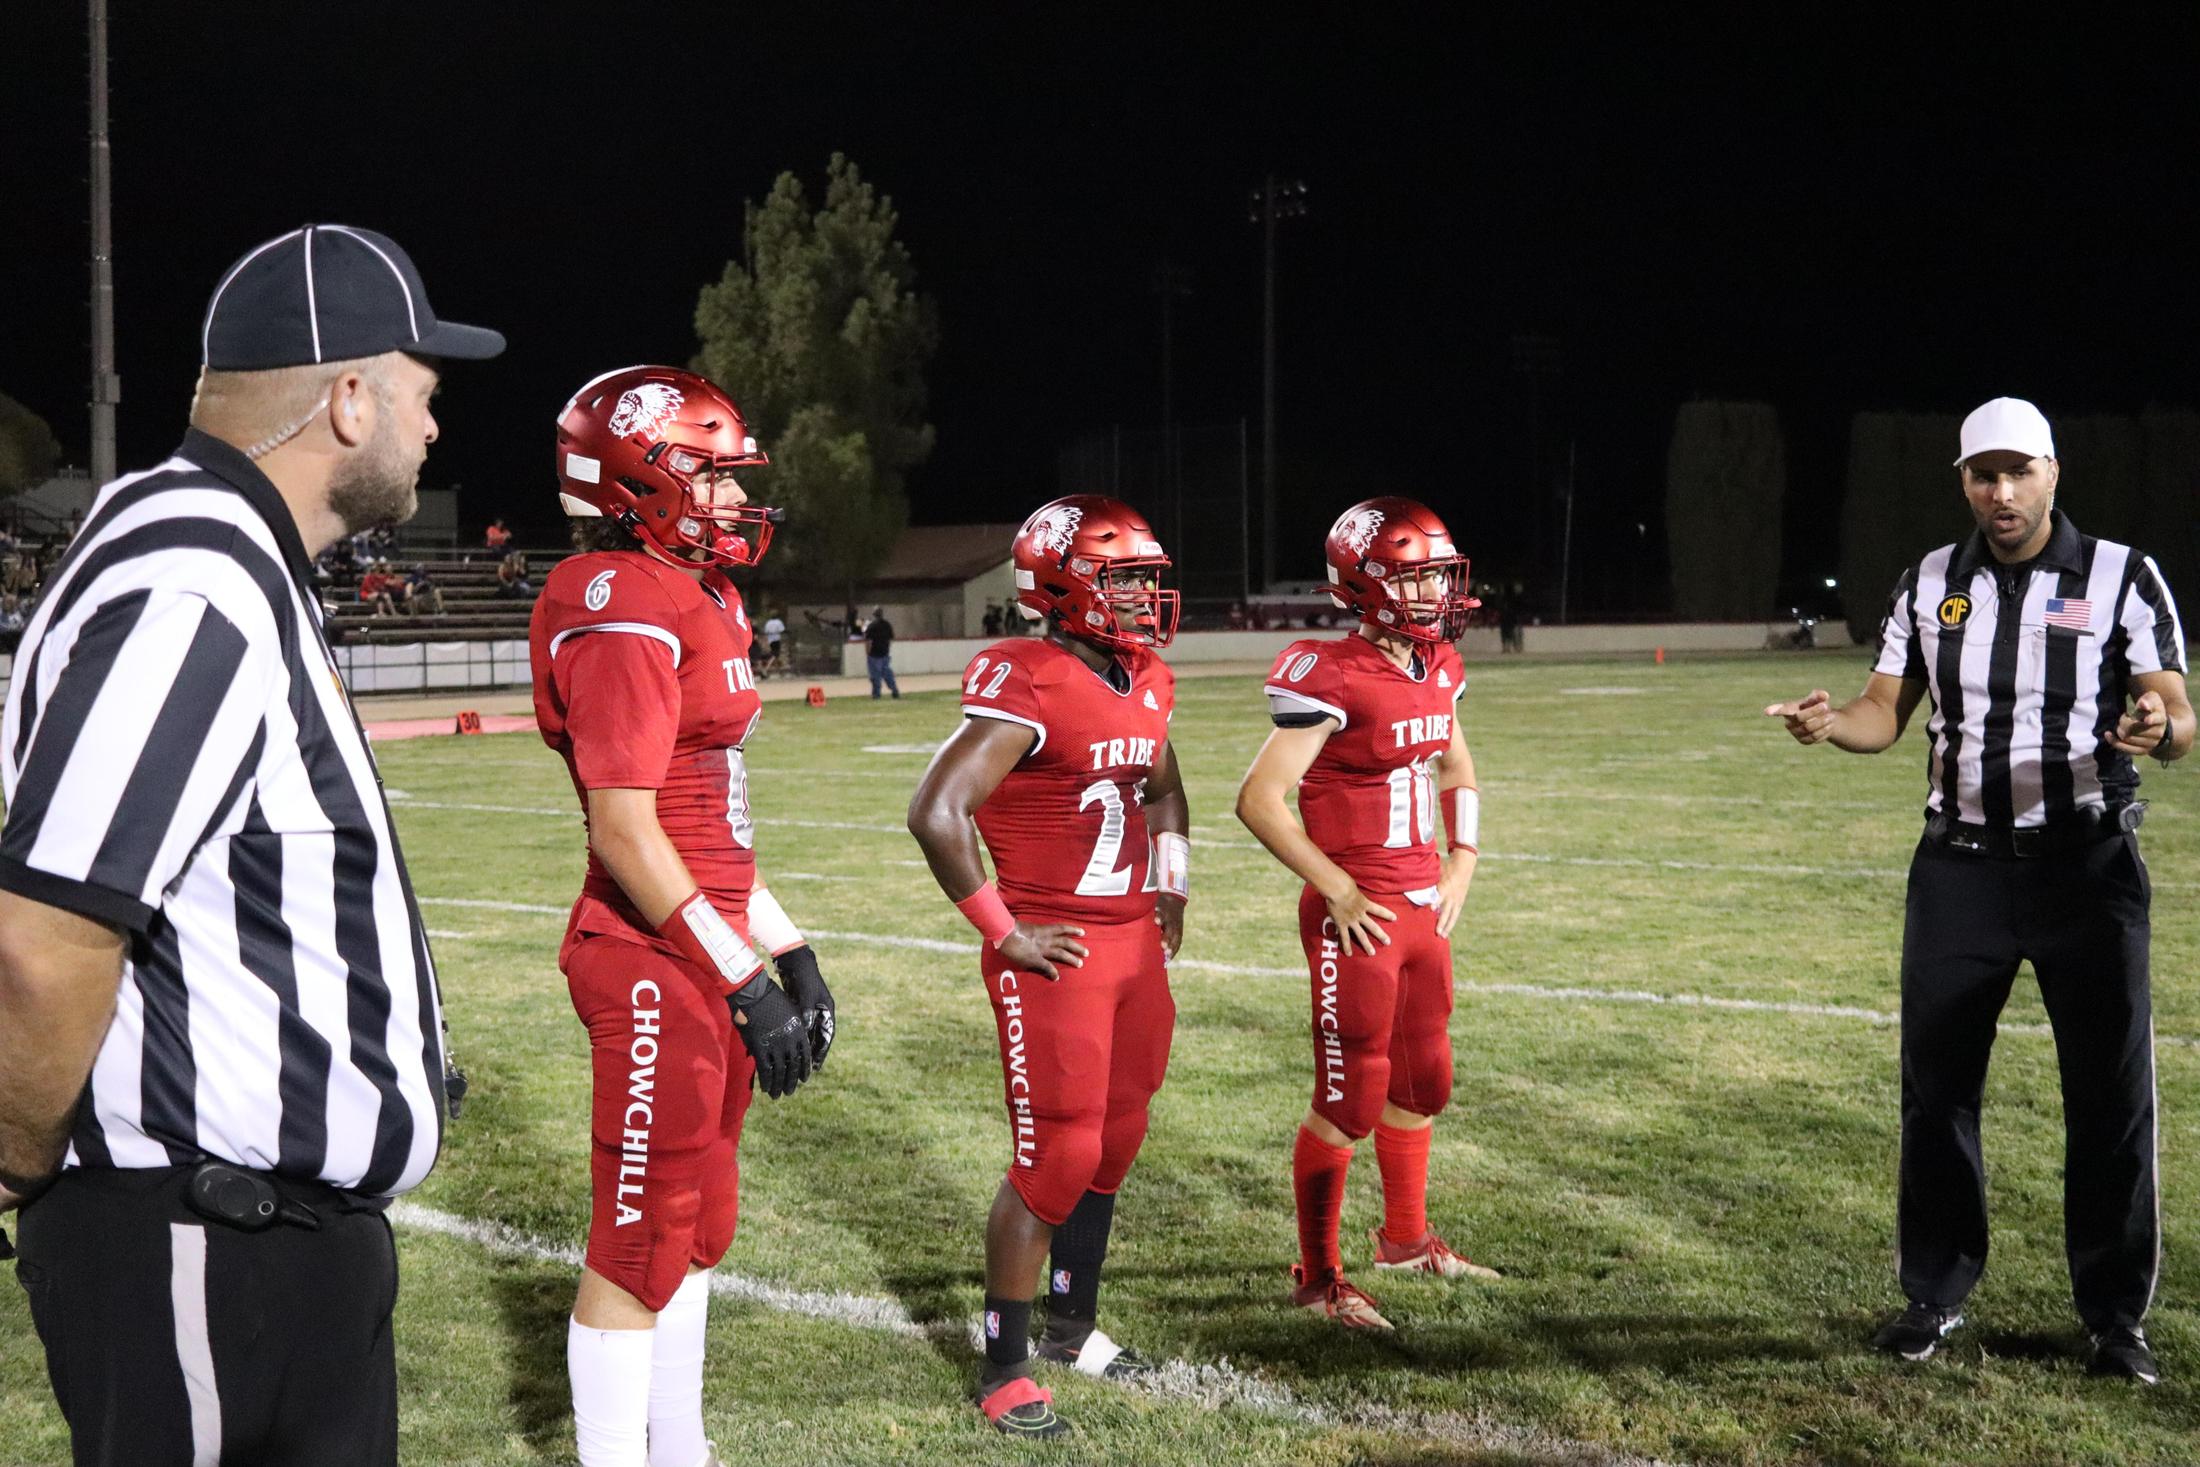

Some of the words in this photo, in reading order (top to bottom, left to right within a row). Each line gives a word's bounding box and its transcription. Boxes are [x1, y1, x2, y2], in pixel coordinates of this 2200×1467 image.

[585, 570, 617, 611] 6
[1940, 597, 1968, 625] CIF
[722, 657, 756, 694] TRI
[965, 658, 1012, 699] 22
[1273, 651, 1318, 683] 10
[462, 711, 481, 731] 30
[1391, 714, 1452, 748] TRIBE
[1089, 737, 1156, 770] TRIBE
[1320, 916, 1345, 1104] CHOWCHILLA
[999, 969, 1036, 1168] CHOWCHILLA
[615, 979, 662, 1228] CHOWCHILLA
